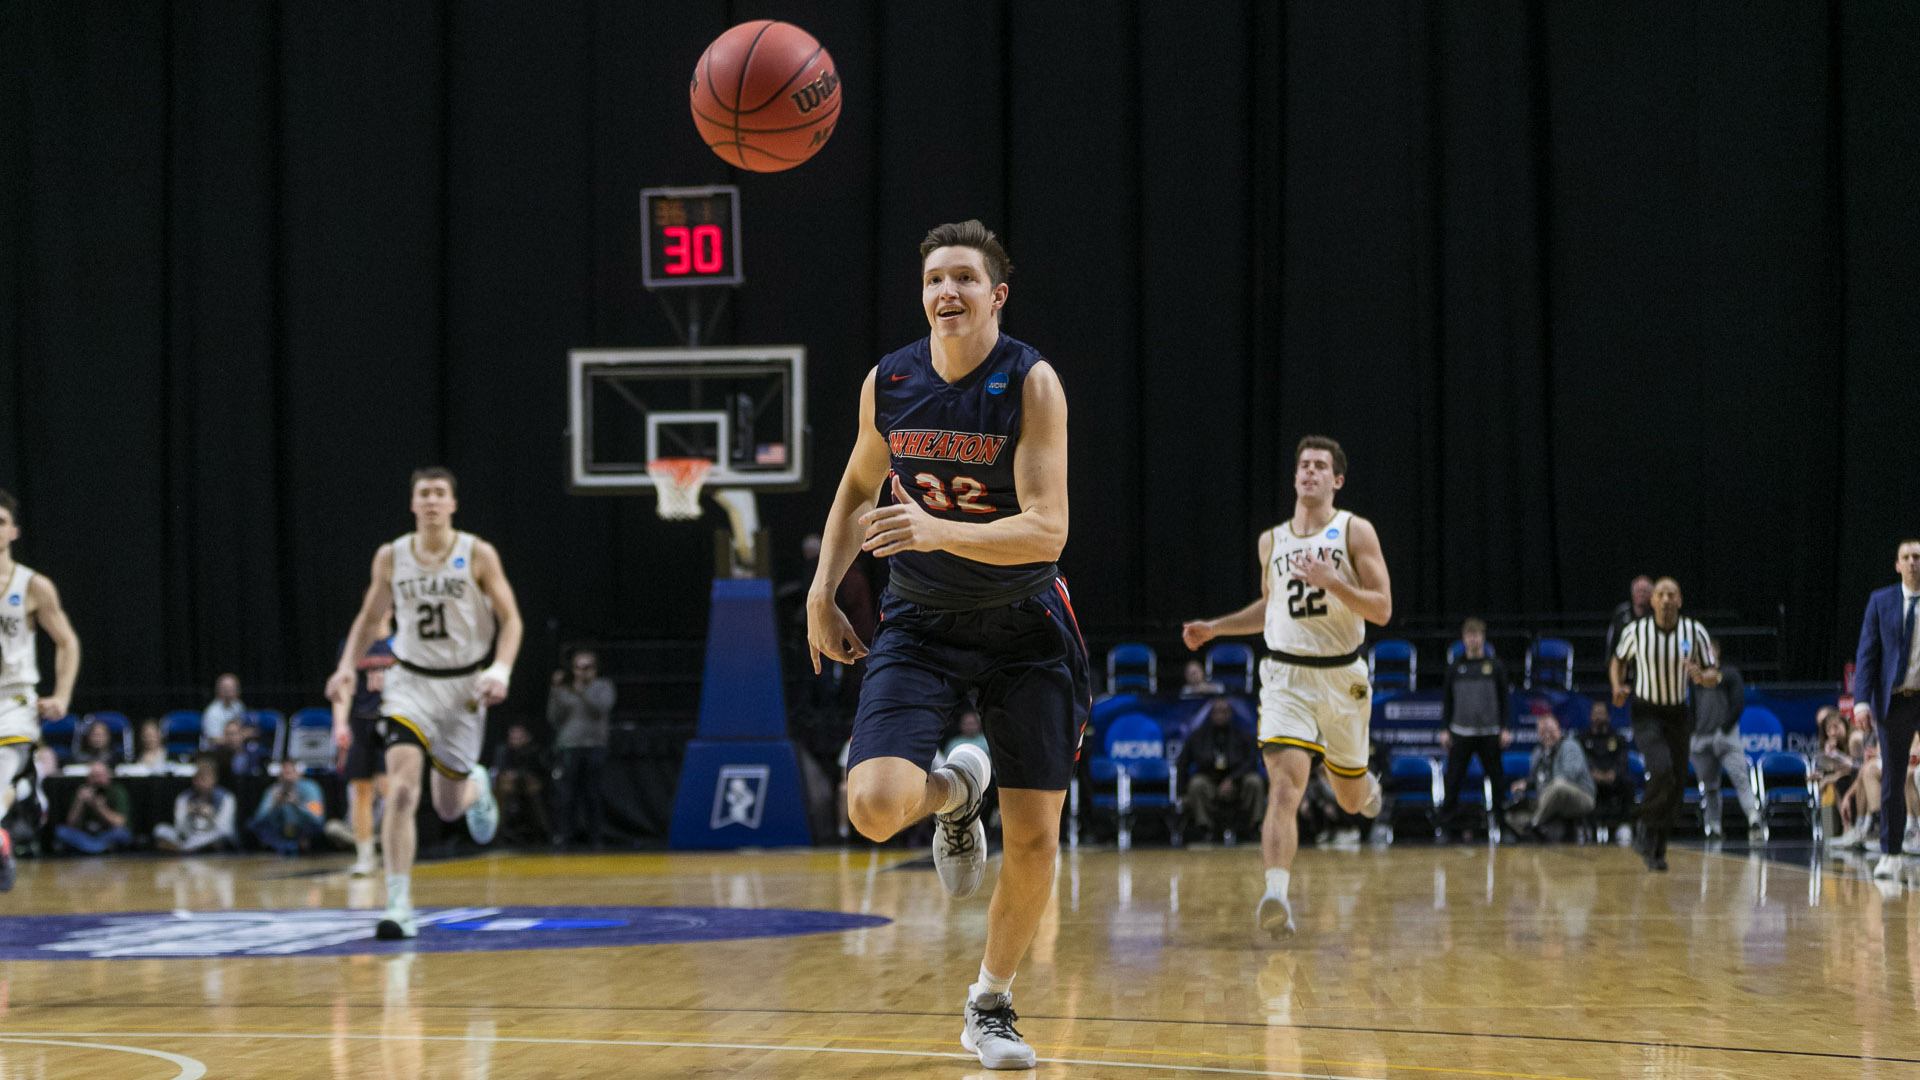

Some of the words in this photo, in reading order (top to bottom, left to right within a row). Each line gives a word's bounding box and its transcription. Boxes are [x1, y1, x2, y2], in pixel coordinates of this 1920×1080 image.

[664, 225, 723, 274] 30
[889, 429, 1007, 465] WHEATON
[915, 472, 996, 513] 32
[398, 577, 466, 600] TITANS
[1287, 579, 1327, 619] 22
[417, 603, 448, 639] 21
[1111, 740, 1163, 759] NCAA
